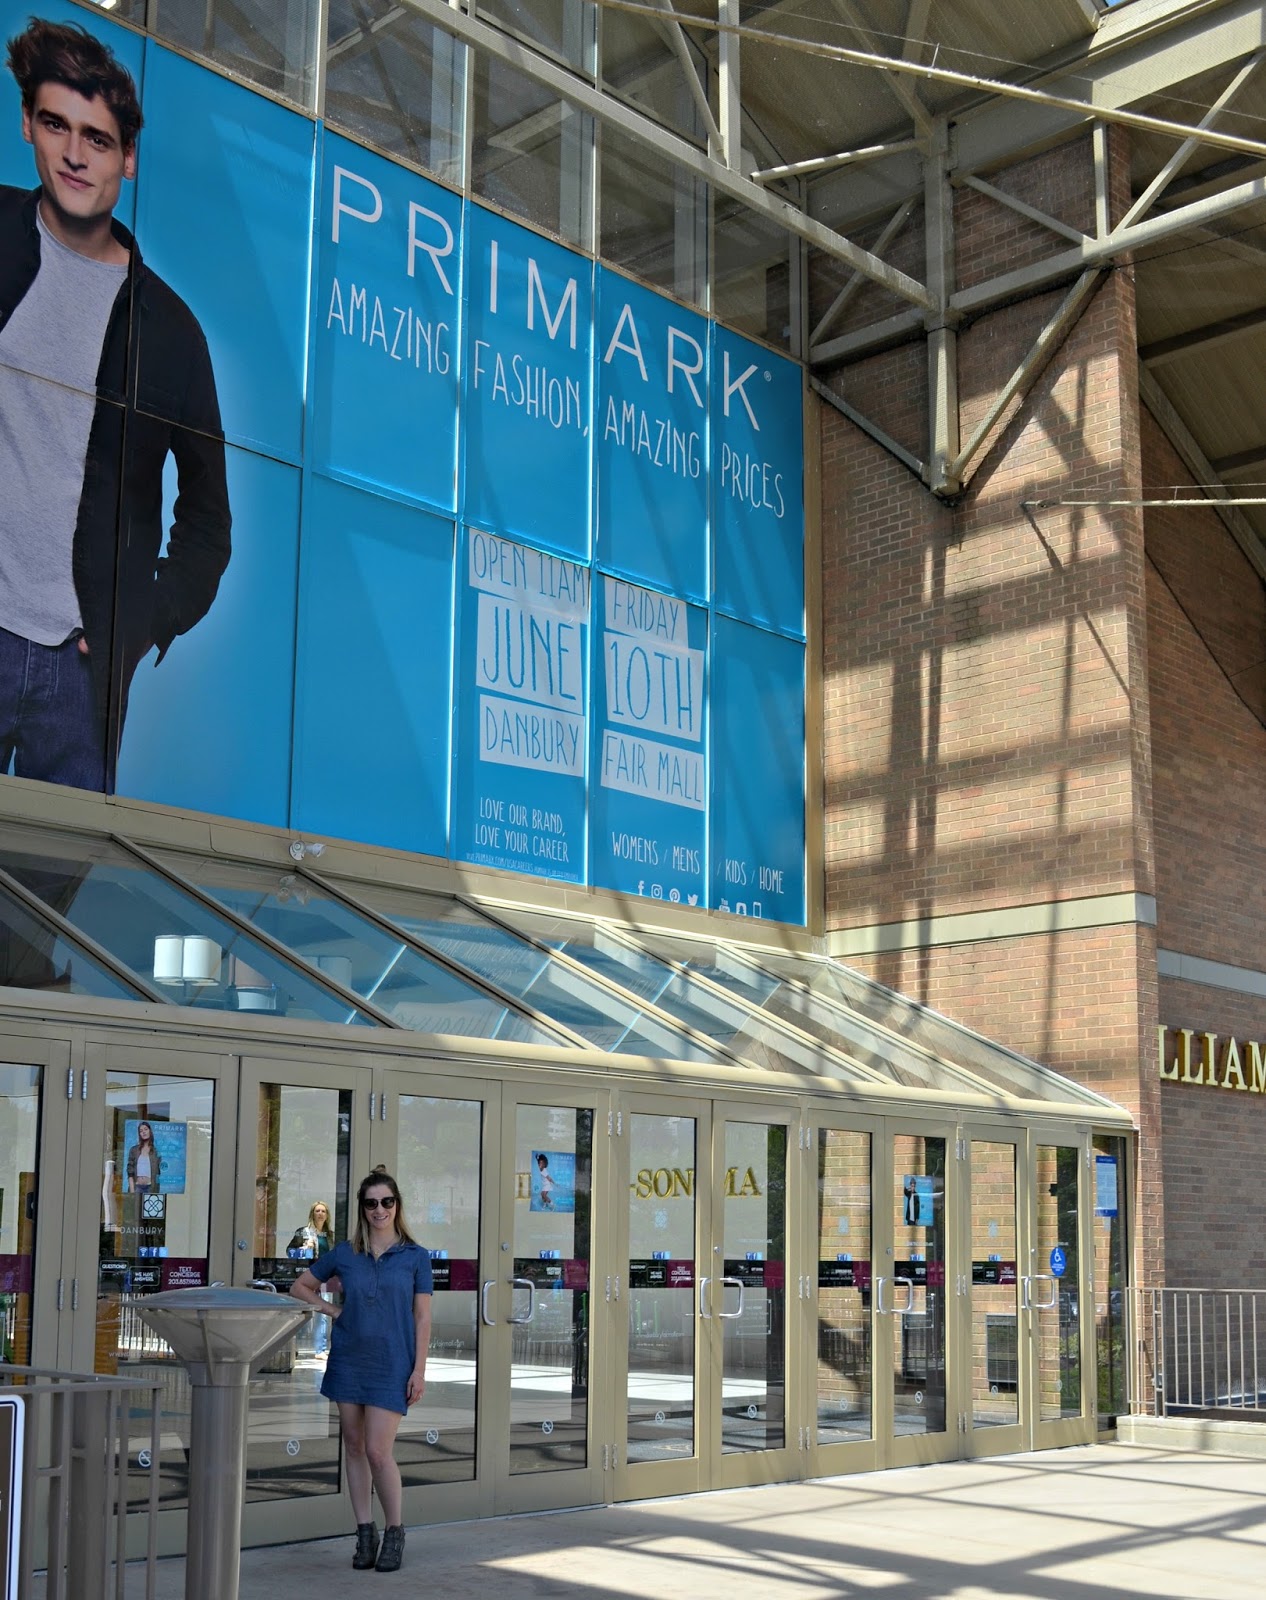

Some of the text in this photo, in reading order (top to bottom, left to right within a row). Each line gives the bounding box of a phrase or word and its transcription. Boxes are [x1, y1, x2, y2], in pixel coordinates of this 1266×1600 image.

[327, 277, 785, 519] AMAZING FASHION, AMAZING PRICES
[473, 533, 586, 608] OPEN 11AM
[612, 582, 679, 641] FRIDAY
[482, 606, 577, 701] JUNE
[610, 640, 693, 733] 10TH
[485, 706, 579, 769] DANBURY
[605, 736, 702, 803] FAIR MALL
[475, 823, 570, 863] LOVE YOUR CAREER
[479, 797, 566, 837] LOVE OUR BRAND,
[611, 831, 785, 895] WOMENS MENS KIDS HOME
[120, 1226, 163, 1235] DANBURY
